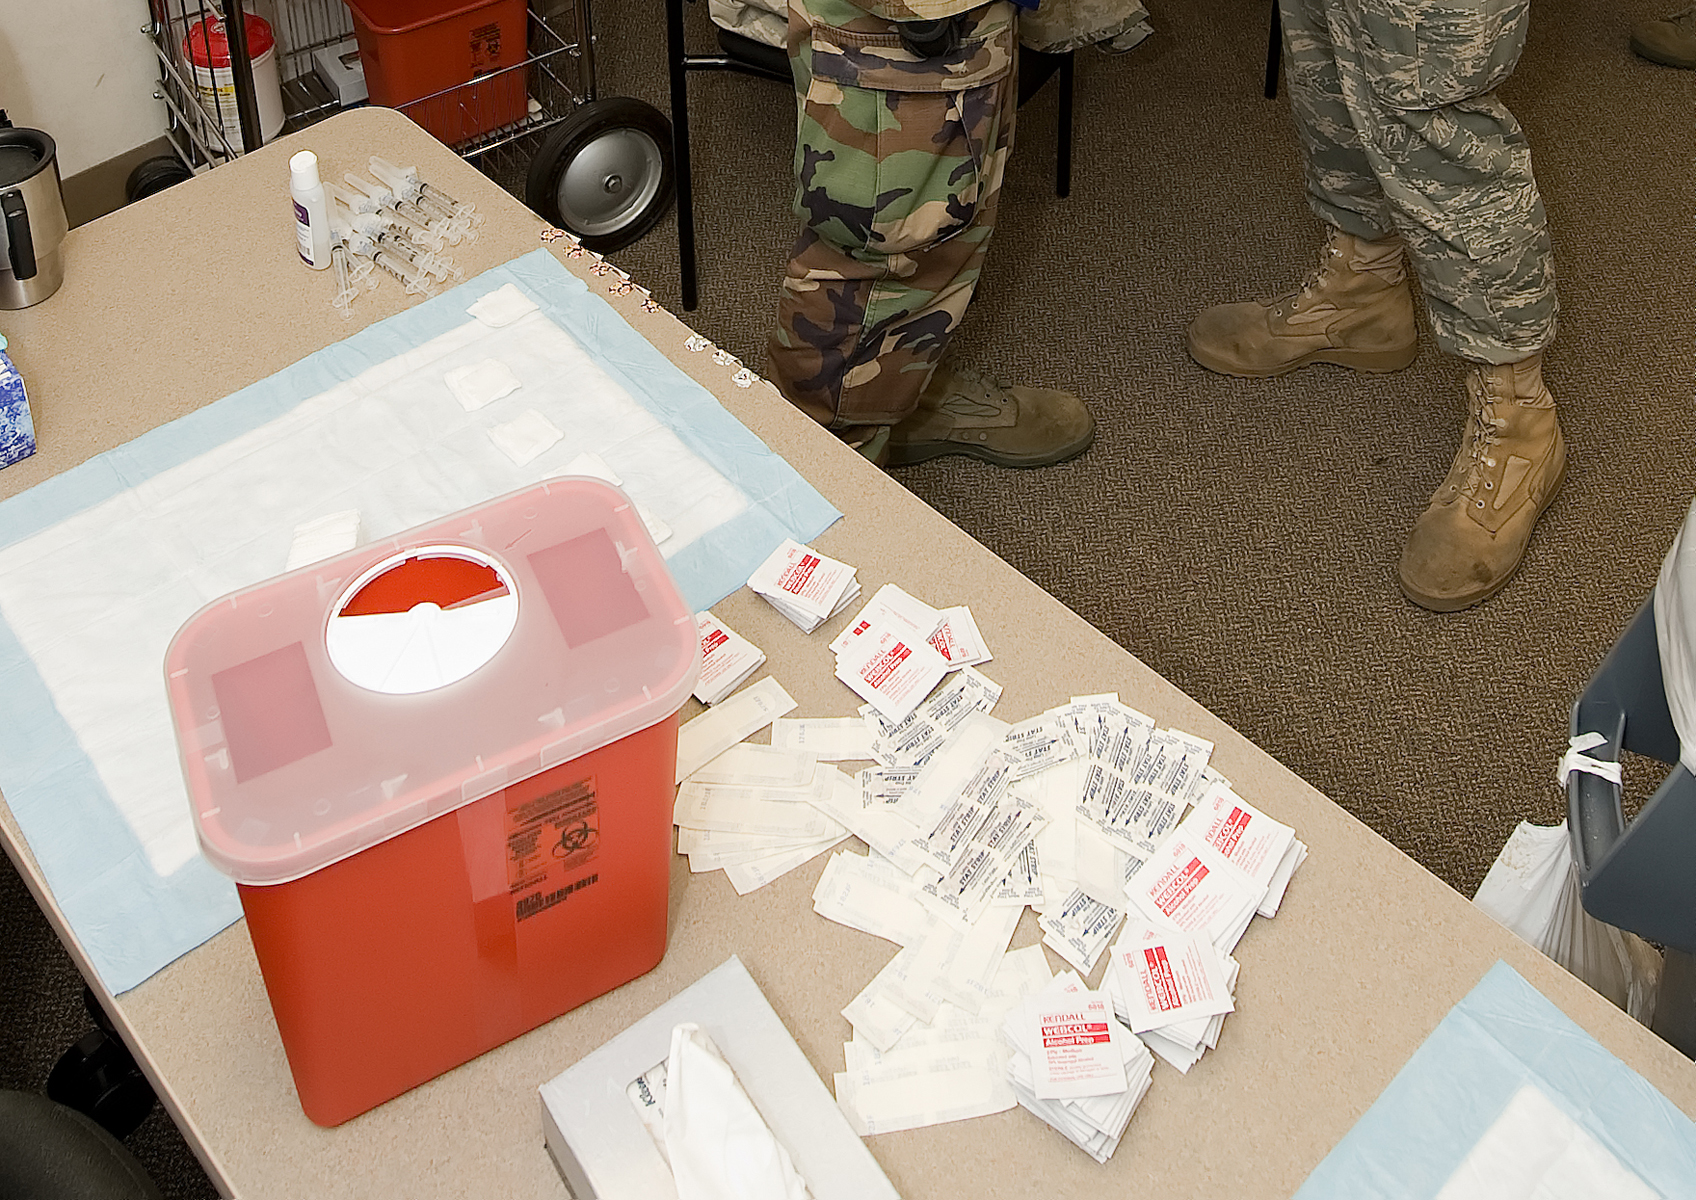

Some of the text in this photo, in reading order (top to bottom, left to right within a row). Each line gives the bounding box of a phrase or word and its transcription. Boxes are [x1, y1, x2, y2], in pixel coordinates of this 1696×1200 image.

[860, 649, 886, 675] KENDALL
[976, 770, 1001, 804] STAT STRIP
[950, 807, 975, 842] STAT STRIP
[988, 814, 1013, 848] STAT STRIP
[1205, 818, 1222, 842] NDALL
[959, 851, 985, 885] STAT STRIP
[1149, 864, 1180, 896] KENDALL
[1071, 898, 1087, 917] STRIP
[1091, 916, 1108, 935] STRIP
[1140, 969, 1156, 1010] KENDALL
[1043, 1014, 1086, 1024] KENDALL
[1046, 1036, 1095, 1047] Alcohol Prep
